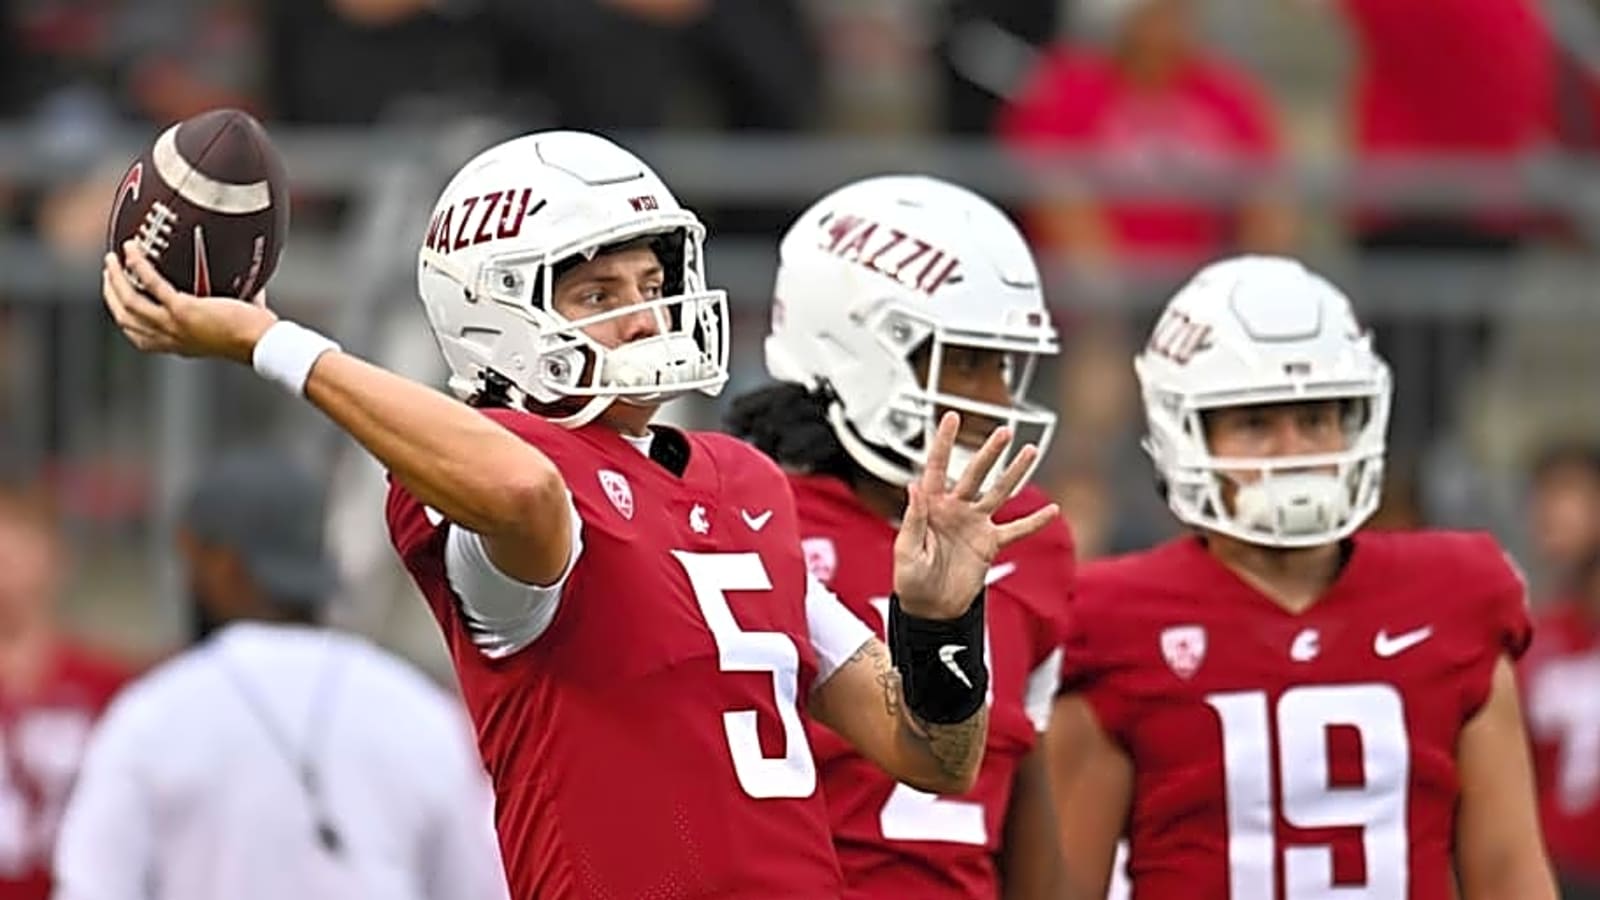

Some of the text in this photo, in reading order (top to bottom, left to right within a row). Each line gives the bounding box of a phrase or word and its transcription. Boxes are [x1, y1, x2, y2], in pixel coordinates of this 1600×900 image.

[426, 187, 532, 255] WAZZU
[671, 549, 817, 799] 5
[1203, 682, 1409, 900] 19
